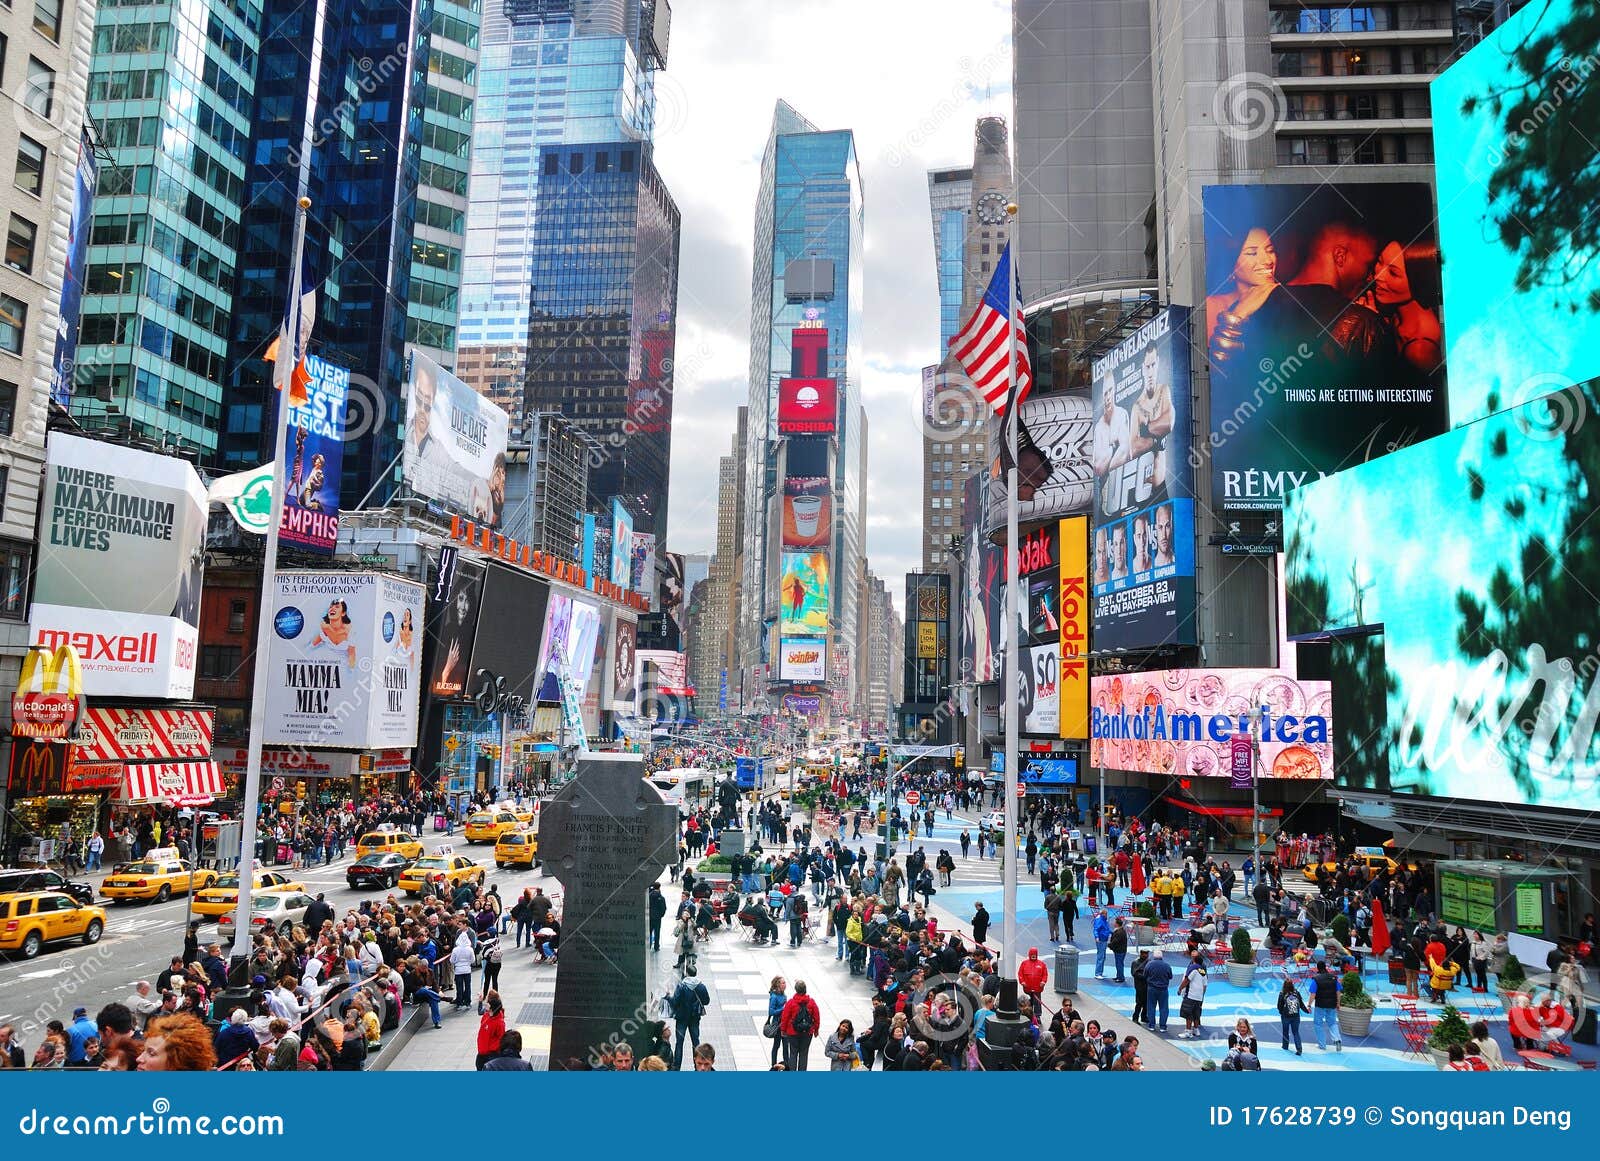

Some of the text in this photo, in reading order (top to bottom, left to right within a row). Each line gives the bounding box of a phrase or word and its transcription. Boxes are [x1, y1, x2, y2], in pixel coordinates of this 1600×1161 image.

[799, 320, 822, 328] 2010
[1092, 348, 1119, 383] LESNAR
[1123, 310, 1170, 361] VELASQUEZ
[300, 388, 343, 423] EST
[1285, 389, 1316, 402] THINGS
[1319, 389, 1335, 402] ARE
[1338, 389, 1374, 402] GETTING
[451, 407, 487, 446] DUE DATE
[780, 422, 834, 432] TOSHIBA
[57, 465, 115, 491] WHERE
[1102, 451, 1154, 516] UFC
[1223, 468, 1307, 497] RÉMY
[54, 483, 174, 525] MAXIMUM
[53, 507, 172, 540] PERFORMANCE
[280, 506, 338, 540] EMPHIS
[50, 524, 110, 551] LIVES
[293, 576, 336, 585] FEEL-GOOD
[340, 576, 375, 585] MUSICAL
[1095, 605, 1108, 617] LIVE
[1110, 603, 1121, 614] ON
[1122, 591, 1175, 611] PAY-PER-VIEW
[1099, 596, 1114, 607] SAT.
[1116, 586, 1154, 602] OCTOBER
[1156, 581, 1168, 593] 23
[920, 635, 934, 643] LION
[1062, 576, 1084, 681] Kodak
[38, 629, 157, 663] maxell
[788, 651, 819, 664] Seinfeld
[920, 644, 934, 652] KING
[80, 663, 153, 673] ww.maxell.com
[285, 664, 341, 689] MAMMA
[383, 666, 407, 689] MAMMA
[1037, 651, 1056, 686] SO
[15, 702, 75, 712] McDonald's
[294, 689, 329, 713] MIA!
[387, 690, 402, 713] MIA!
[23, 711, 64, 719] Restaurant
[1092, 704, 1327, 743] Bank of America
[120, 731, 148, 740] FRIDAY'S
[173, 732, 197, 740] FRIDAY'S
[162, 777, 181, 785] FRIDAY'S
[565, 824, 605, 833] FRANCIS
